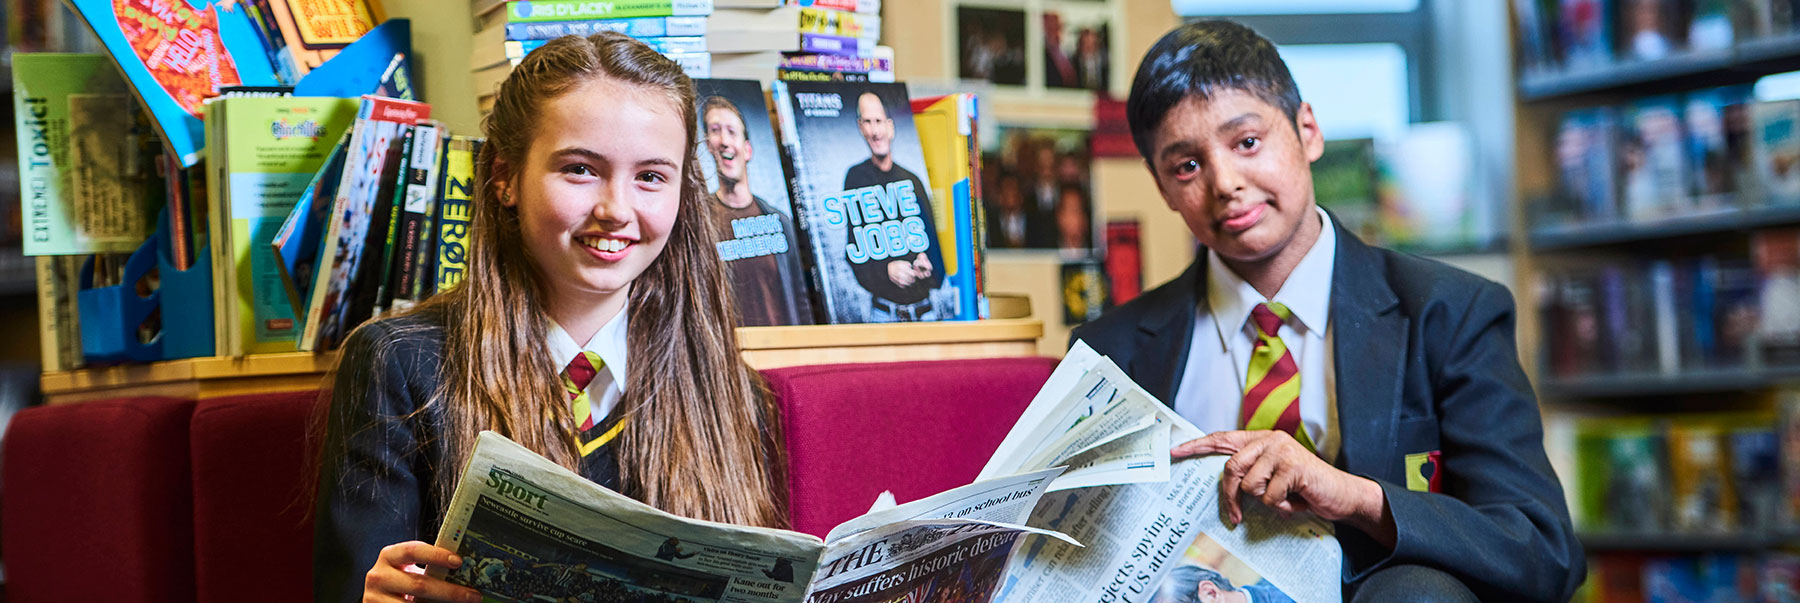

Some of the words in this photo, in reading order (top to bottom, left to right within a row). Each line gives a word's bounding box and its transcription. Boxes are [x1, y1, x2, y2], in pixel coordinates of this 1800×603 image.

[558, 2, 613, 16] D'LACEY
[162, 29, 200, 73] HELLO
[24, 96, 49, 171] Toxic!
[731, 213, 784, 239] MARK
[820, 180, 921, 231] STEVE
[716, 233, 789, 261] ERBERG
[846, 216, 930, 264] JOBS
[486, 467, 550, 511] Sport
[957, 506, 972, 519] on
[972, 492, 1012, 514] school
[1177, 485, 1196, 508] stores
[1185, 488, 1207, 516] closure
[1203, 474, 1216, 490] list
[480, 495, 520, 520] Newcastle
[519, 515, 550, 532] survive
[549, 528, 565, 539] cup
[565, 533, 588, 547] scare
[1042, 558, 1057, 577] can
[1070, 515, 1088, 537] after
[1086, 488, 1110, 517] selling
[1131, 511, 1173, 562] spying
[820, 538, 888, 580] THE
[843, 571, 907, 601] suffers
[907, 545, 969, 583] historic
[1127, 570, 1151, 595] US
[1148, 518, 1191, 573] attacks
[729, 586, 746, 595] two
[746, 589, 779, 600] months
[733, 576, 756, 588] Kane
[756, 582, 771, 590] out
[772, 583, 786, 592] for
